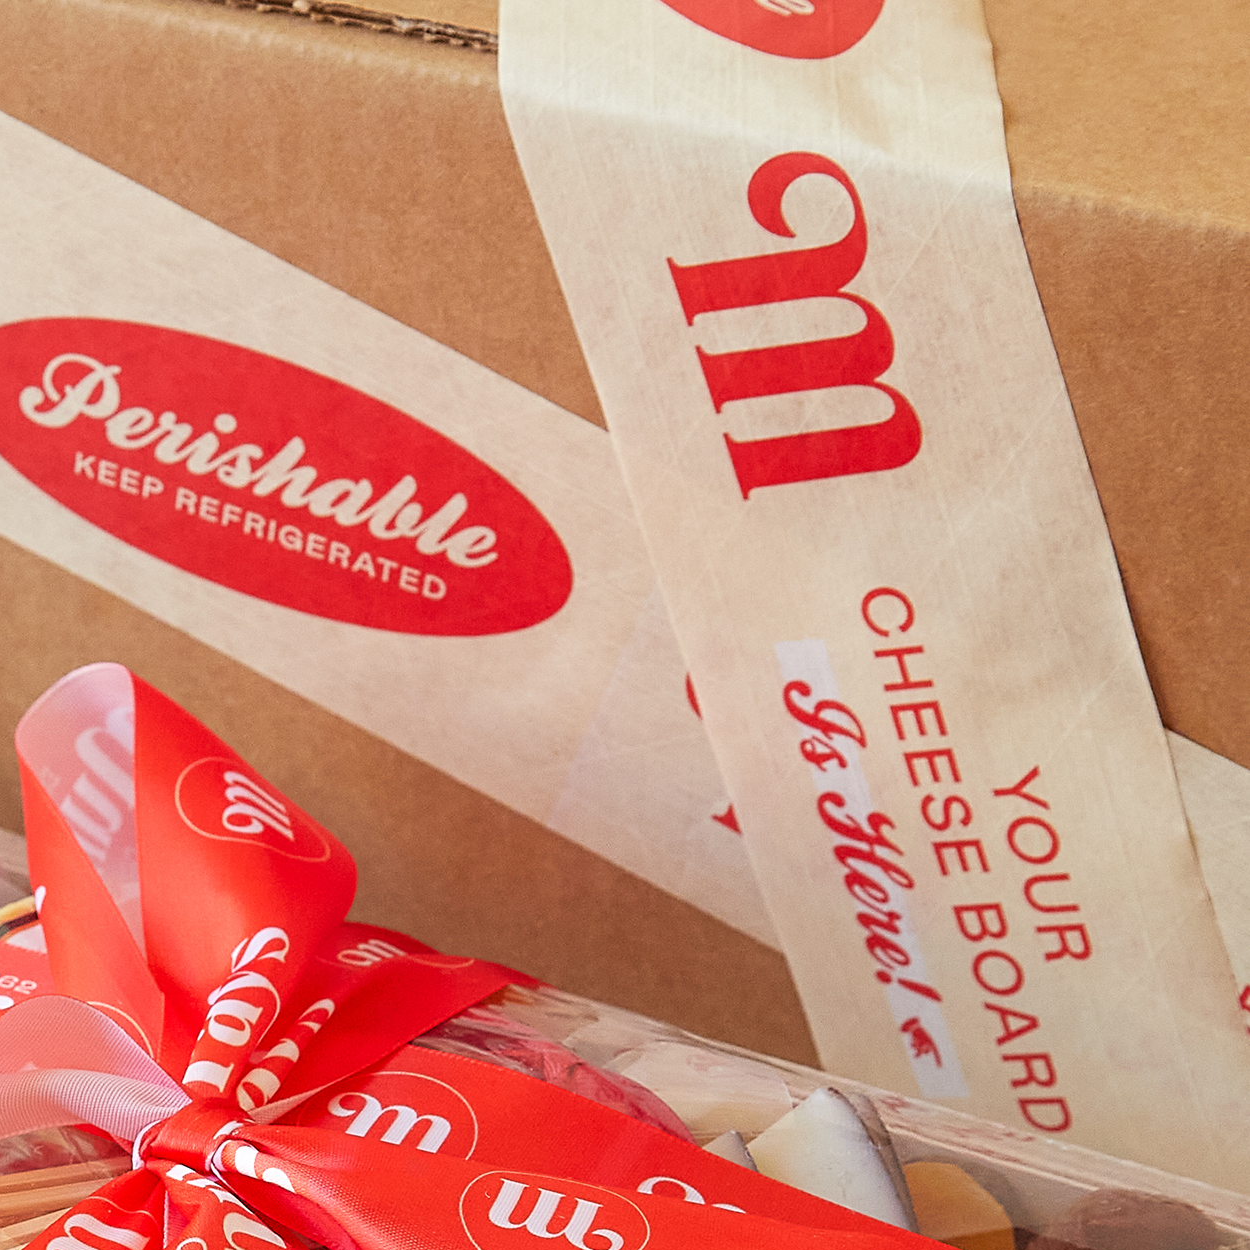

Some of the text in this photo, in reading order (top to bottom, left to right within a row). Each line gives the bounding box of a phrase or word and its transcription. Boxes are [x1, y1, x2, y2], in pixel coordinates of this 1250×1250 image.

[17, 352, 501, 569] Perishable
[73, 451, 449, 602] KEEP REFRIGERATED
[817, 791, 943, 1005] Here!
[861, 586, 1073, 1135] CHEESE BOARD
[993, 765, 1093, 964] YOUR
